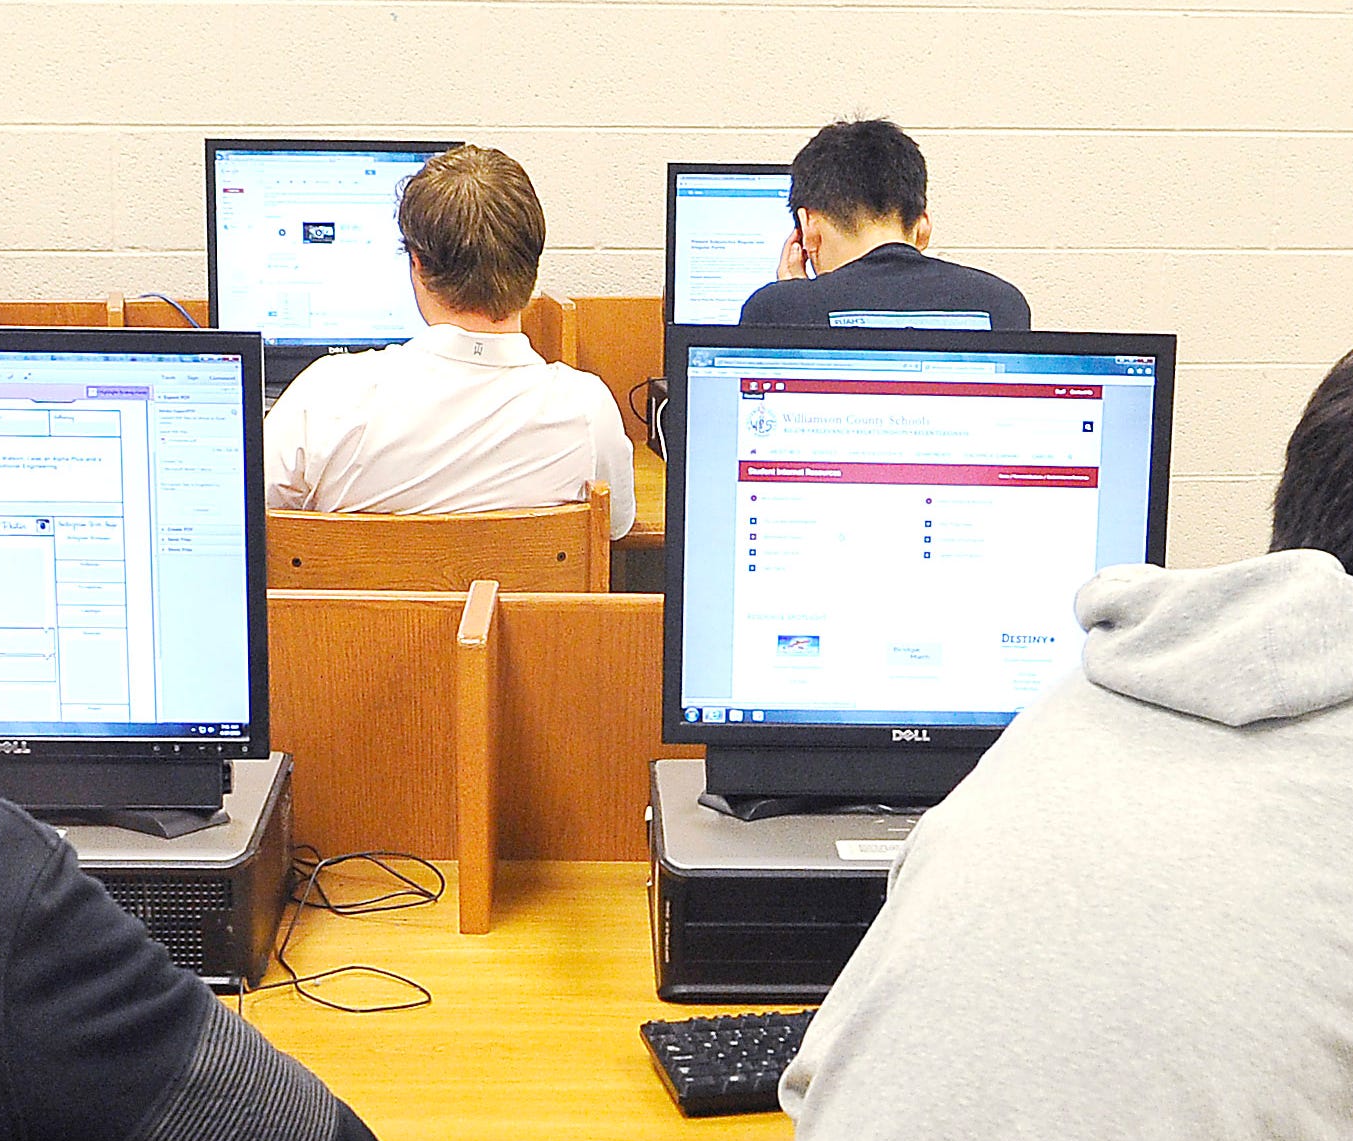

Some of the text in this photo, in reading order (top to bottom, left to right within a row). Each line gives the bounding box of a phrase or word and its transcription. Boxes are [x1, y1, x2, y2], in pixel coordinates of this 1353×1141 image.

[782, 411, 930, 427] Williamson County Schools
[1001, 633, 1048, 643] DESTINY
[892, 729, 931, 742] DELL
